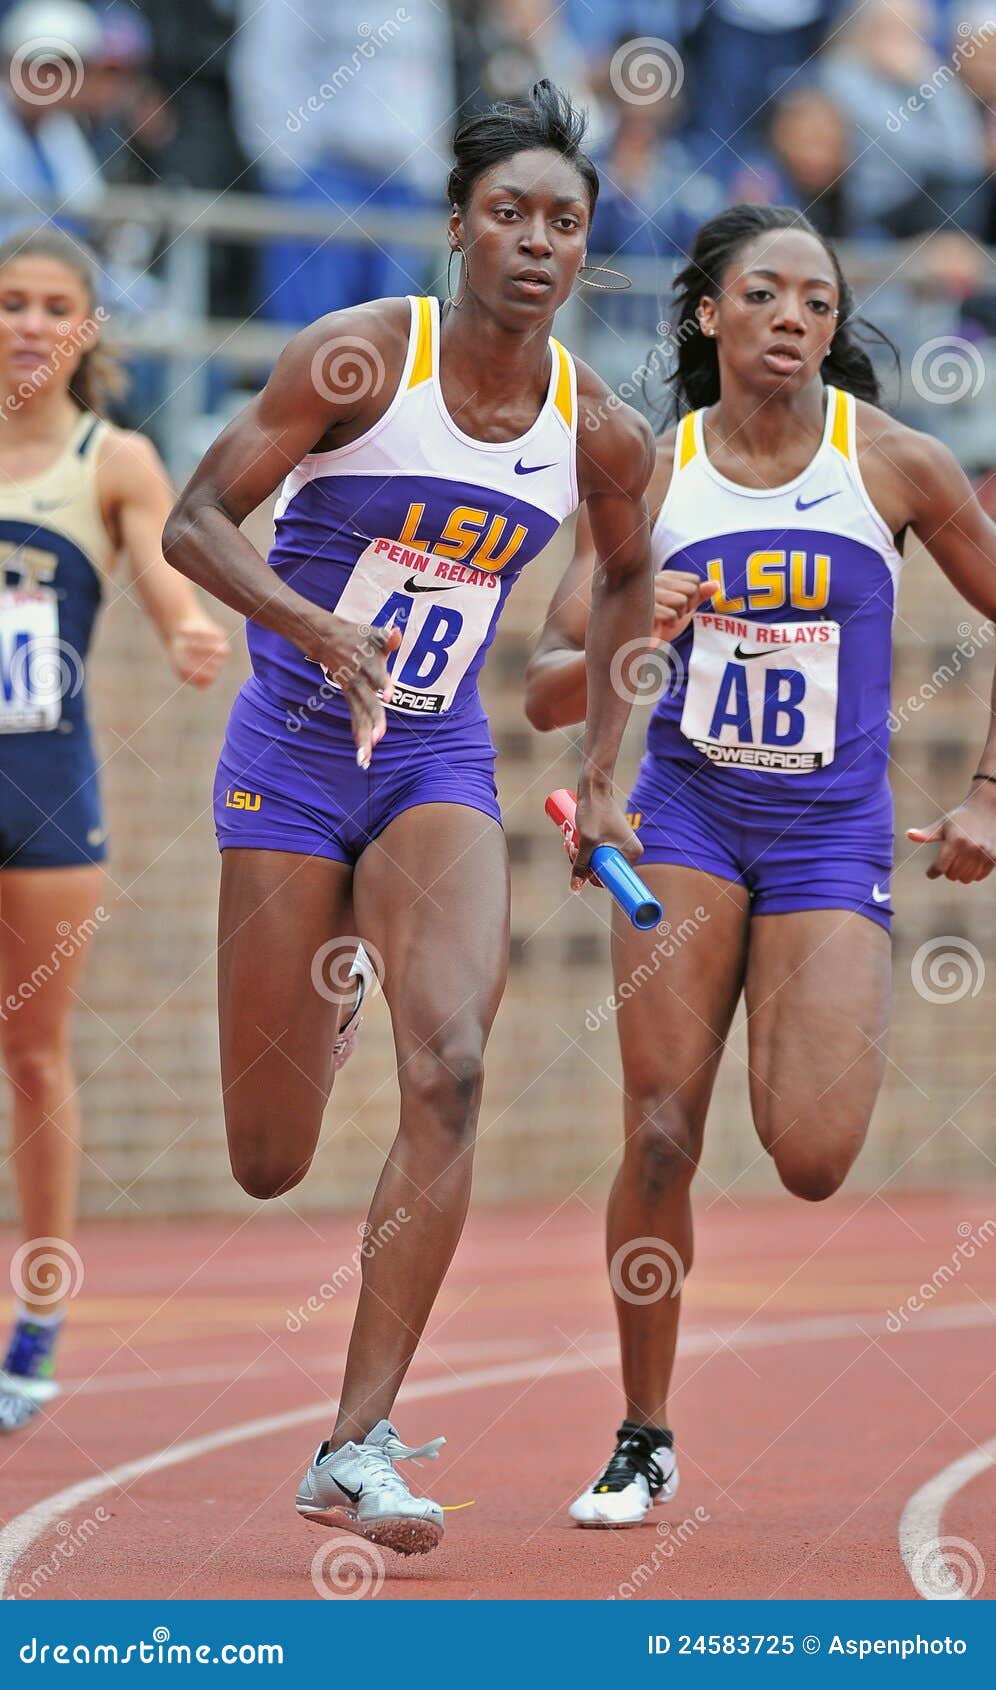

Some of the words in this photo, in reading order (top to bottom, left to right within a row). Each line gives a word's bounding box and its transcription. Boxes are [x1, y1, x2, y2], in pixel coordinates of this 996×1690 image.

[374, 539, 430, 573] PENN
[434, 561, 498, 589] RELAYS
[398, 503, 528, 573] LSU
[706, 550, 831, 614] LSU
[369, 591, 463, 689] AB
[702, 617, 748, 638] PENN
[756, 626, 830, 644] RELAYS
[708, 661, 806, 746] AB
[226, 790, 261, 811] LSU
